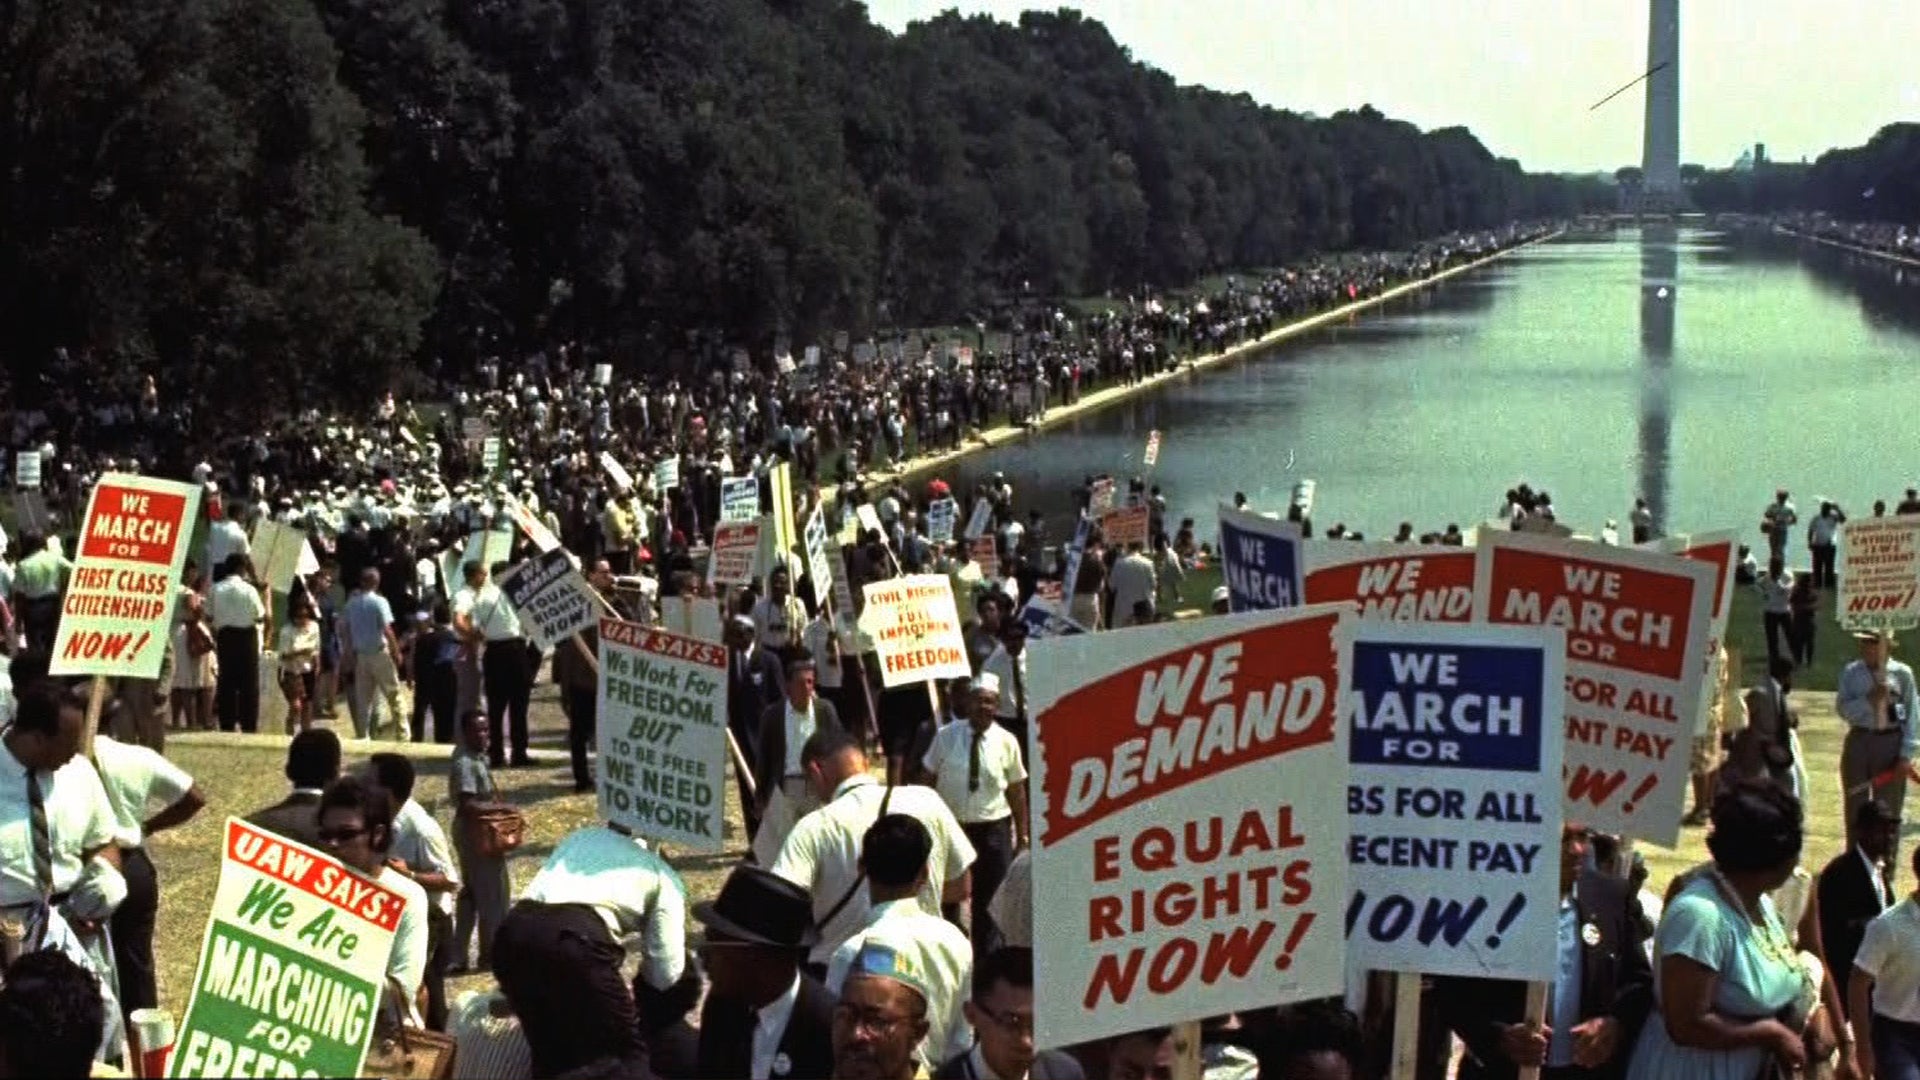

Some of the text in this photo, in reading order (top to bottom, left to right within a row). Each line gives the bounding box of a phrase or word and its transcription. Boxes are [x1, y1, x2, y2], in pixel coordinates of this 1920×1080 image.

[121, 493, 150, 515] WE
[93, 513, 172, 545] MARCH
[108, 543, 140, 557] FOR
[1238, 533, 1266, 568] WE
[75, 567, 168, 595] FIRST CLASS
[1357, 559, 1423, 597] WE
[1563, 564, 1622, 600] WE
[65, 593, 164, 620] CITIZENSHIP
[526, 583, 577, 613] EQUAL
[870, 591, 902, 605] CIVIL
[1356, 586, 1473, 622] MAND
[1847, 584, 1917, 612] NOW!
[544, 601, 592, 639] NOW!
[1503, 588, 1673, 649] MARCH
[62, 630, 151, 661] NOW!
[604, 622, 723, 665] UAW SAYS:
[885, 647, 962, 673] FREEDOM
[1569, 638, 1616, 661] OR
[606, 650, 719, 697] We Work For
[1135, 641, 1243, 727] WE
[1388, 652, 1459, 686] WE
[606, 677, 719, 727] FREEDOM.
[1624, 688, 1678, 722] ALL
[628, 715, 683, 747] BUT
[1061, 675, 1326, 818] DEMAND
[1382, 738, 1461, 761] FOR
[1614, 726, 1674, 760] PAY
[611, 737, 707, 779] TO BE FREE
[605, 755, 712, 807] WE NEED
[1563, 764, 1658, 813] W!
[604, 781, 710, 838] TO WORK
[1347, 785, 1542, 824] BS FOR ALL
[1093, 804, 1305, 882] EQUAL
[1347, 834, 1542, 874] ECENT PAY
[234, 832, 400, 925] UAW SAYS:
[236, 878, 359, 960] We Are
[1088, 859, 1313, 942] RIGHTS
[1082, 912, 1318, 1010] NOW!
[203, 934, 368, 1046] MARCHING
[246, 1019, 313, 1058] FOR
